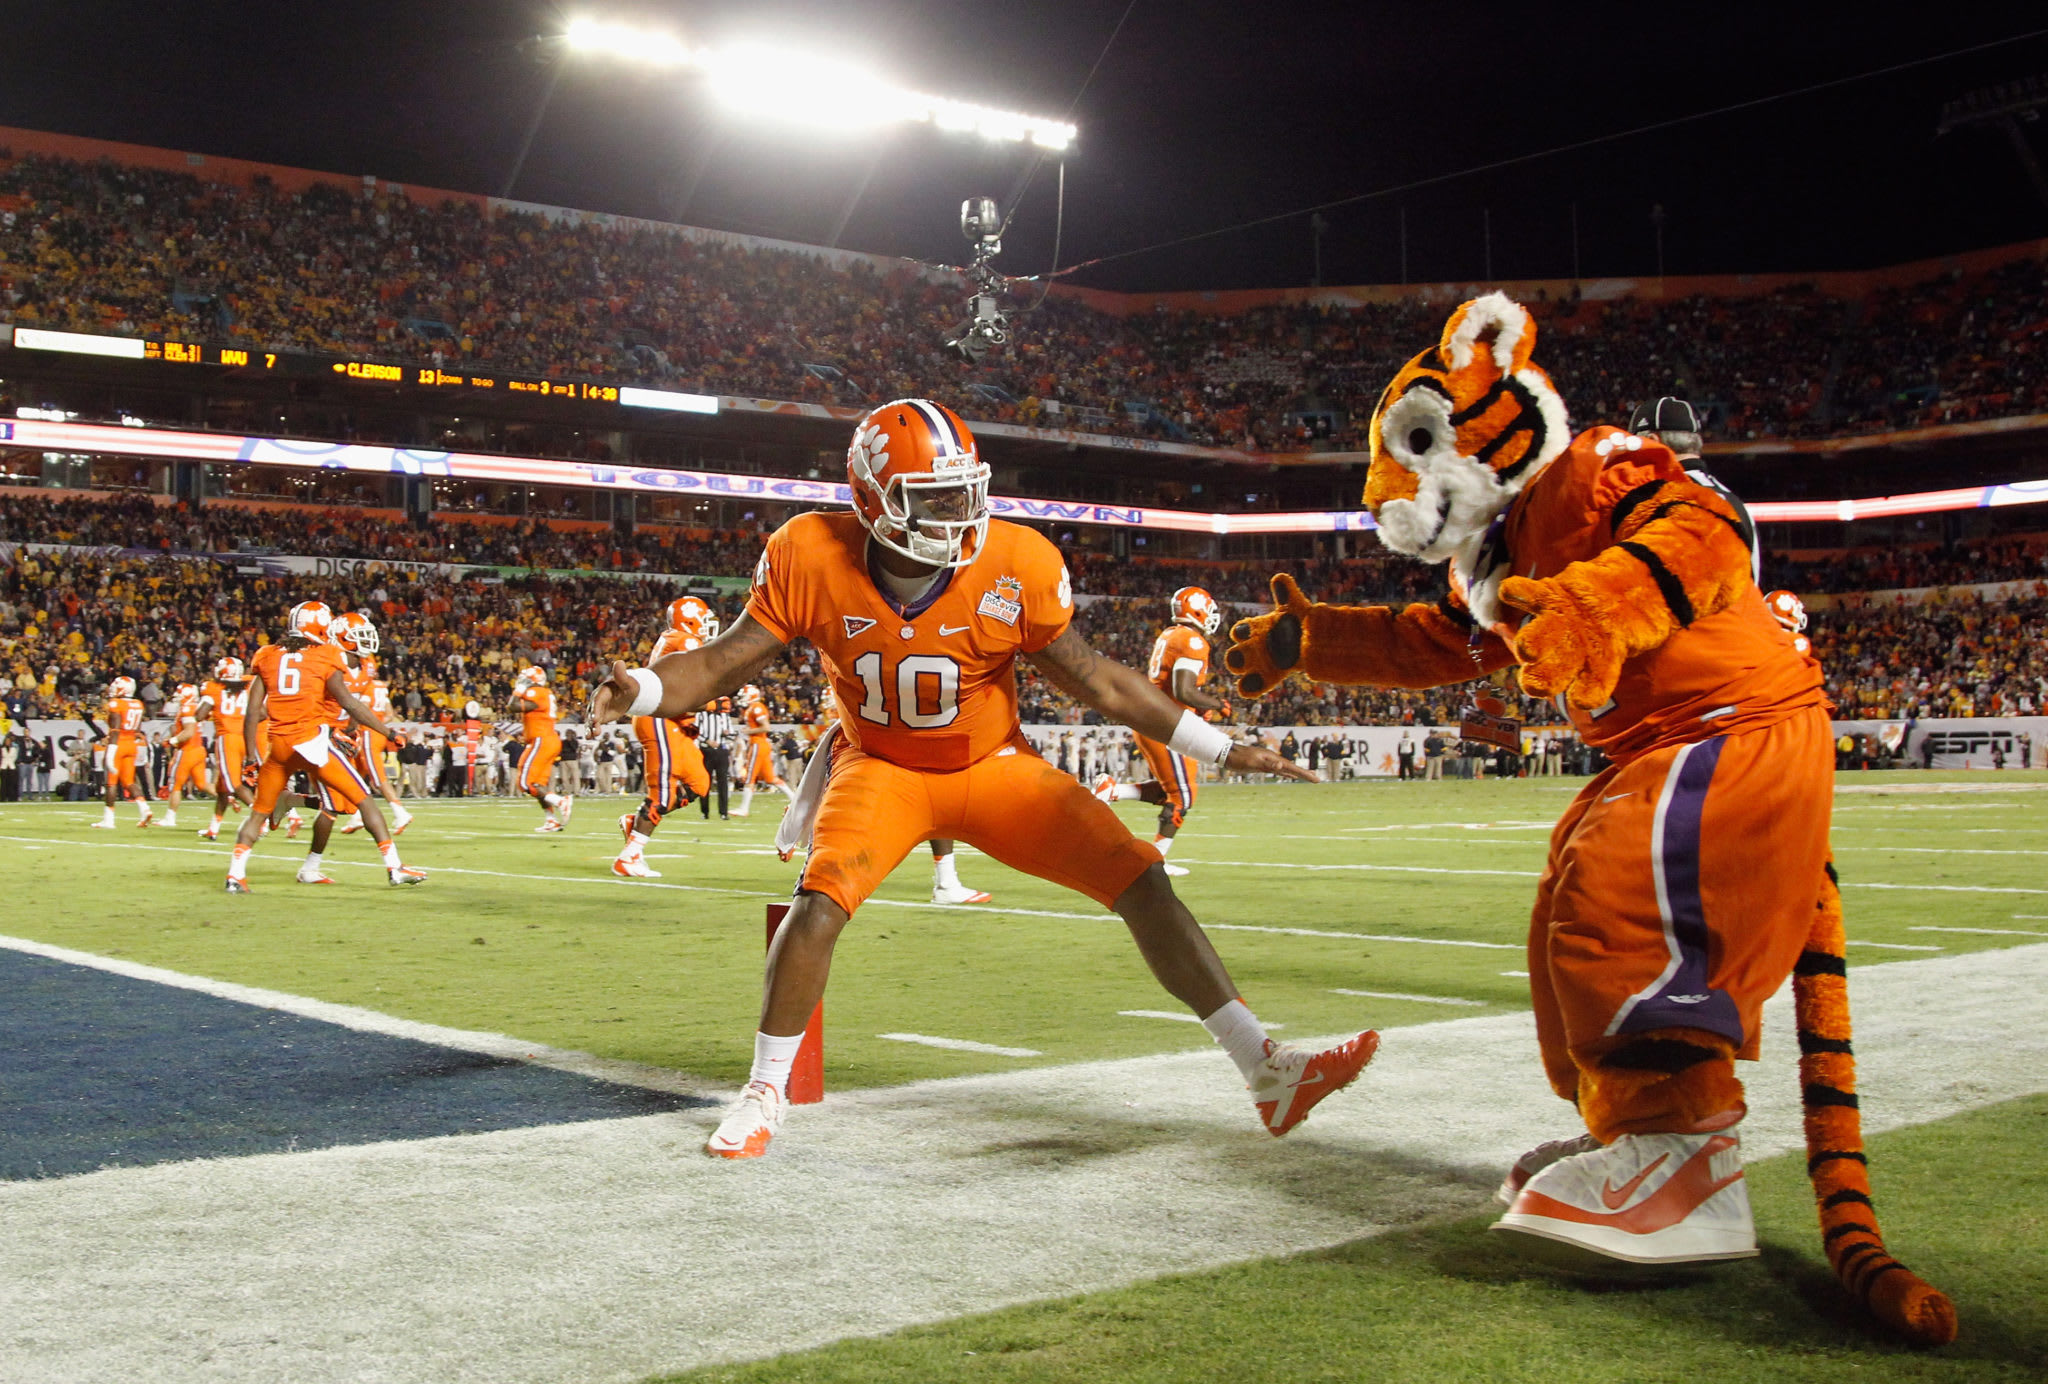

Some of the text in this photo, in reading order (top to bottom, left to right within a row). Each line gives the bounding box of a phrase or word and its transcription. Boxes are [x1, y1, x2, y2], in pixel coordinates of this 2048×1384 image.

[220, 349, 276, 369] WVU 7
[347, 362, 435, 385] CLEMSON 13
[439, 374, 463, 385] DOWN
[539, 380, 550, 395] 3
[567, 383, 576, 397] 1
[945, 458, 966, 468] ACC
[316, 557, 430, 584] DISCOR
[984, 595, 1018, 613] DISCOVER
[277, 652, 303, 696] 6
[854, 651, 960, 730] 10
[221, 689, 248, 716] 84
[124, 708, 144, 731] 97
[1464, 711, 1518, 733] DISCVER
[1927, 731, 2013, 754] ESPN
